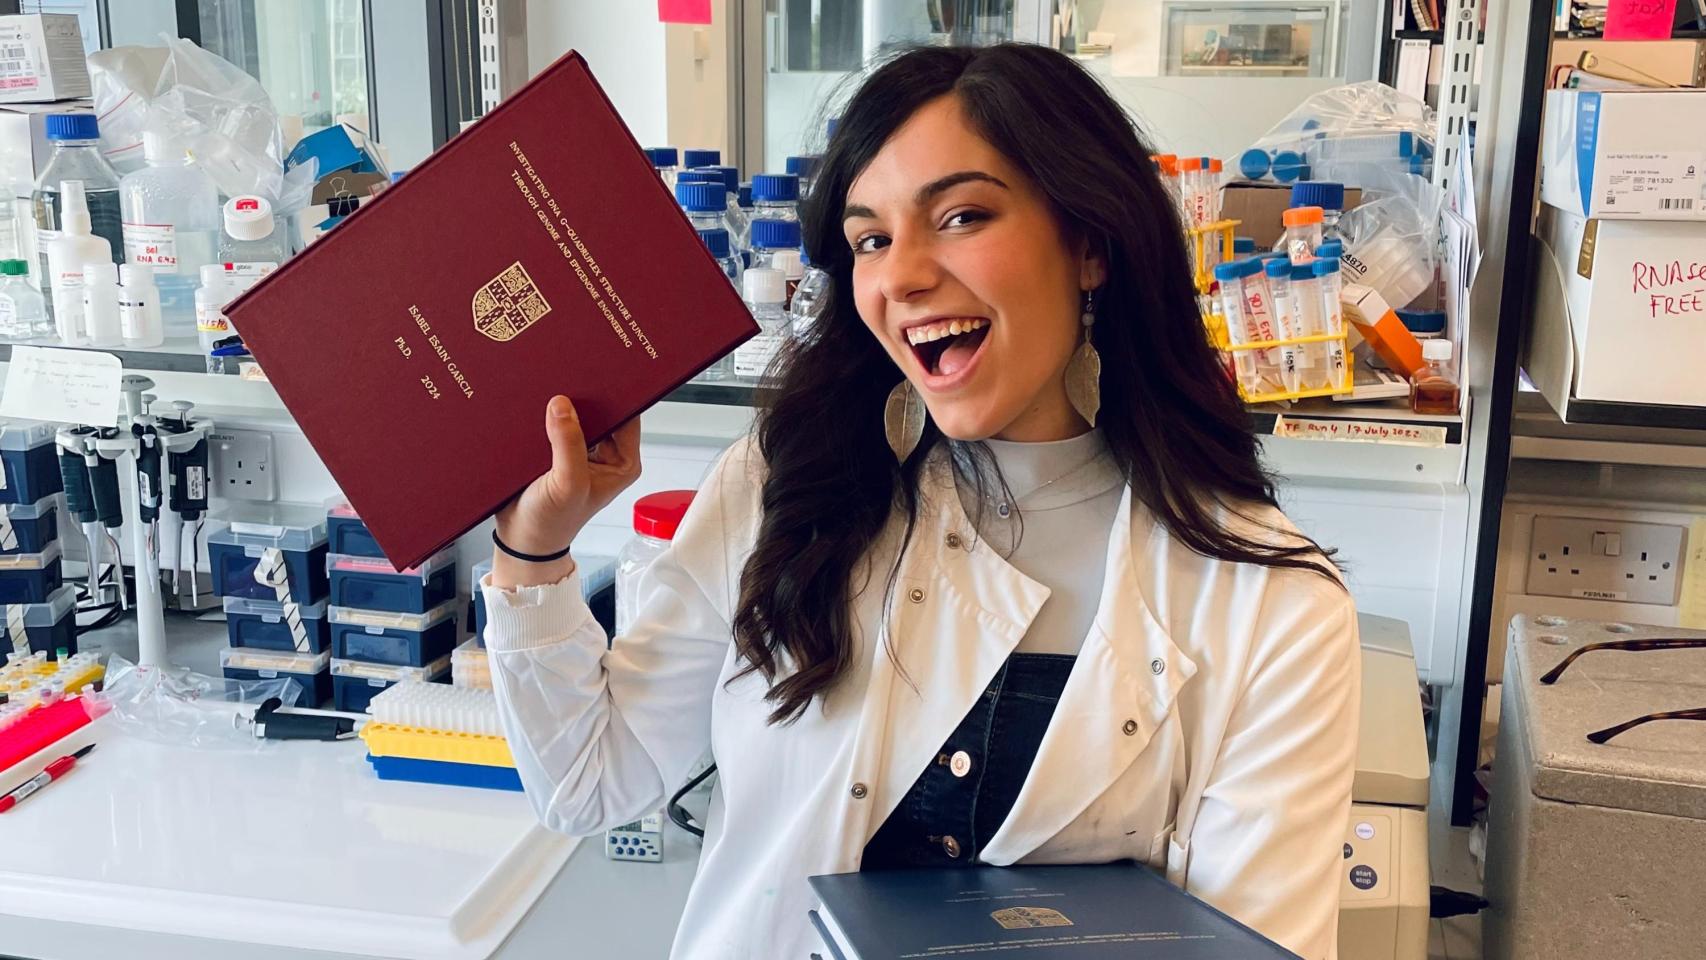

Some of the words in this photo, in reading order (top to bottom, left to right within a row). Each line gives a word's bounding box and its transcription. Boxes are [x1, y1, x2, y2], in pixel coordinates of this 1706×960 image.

[508, 140, 550, 199] INVESTIGATING
[548, 198, 562, 217] DNA
[560, 217, 601, 277] G-QUADRUPLEX
[600, 276, 632, 320] STRUCTURE
[628, 320, 659, 360] FUNCTION
[511, 169, 540, 210] THROUGH
[537, 209, 561, 240] GENOME
[558, 242, 572, 259] AND
[569, 258, 600, 299] EPIGENOME
[597, 299, 633, 348] ENGINEERING
[1649, 289, 1705, 318] FREE
[394, 336, 412, 360] Ph.D.
[420, 374, 441, 400] 2024
[407, 304, 431, 335] ISABEL
[428, 335, 451, 362] ESAIN
[448, 362, 474, 399] GARCIA
[1307, 424, 1328, 433] Run
[1364, 425, 1389, 438] July
[1355, 870, 1372, 878] start
[1355, 878, 1372, 886] stop
